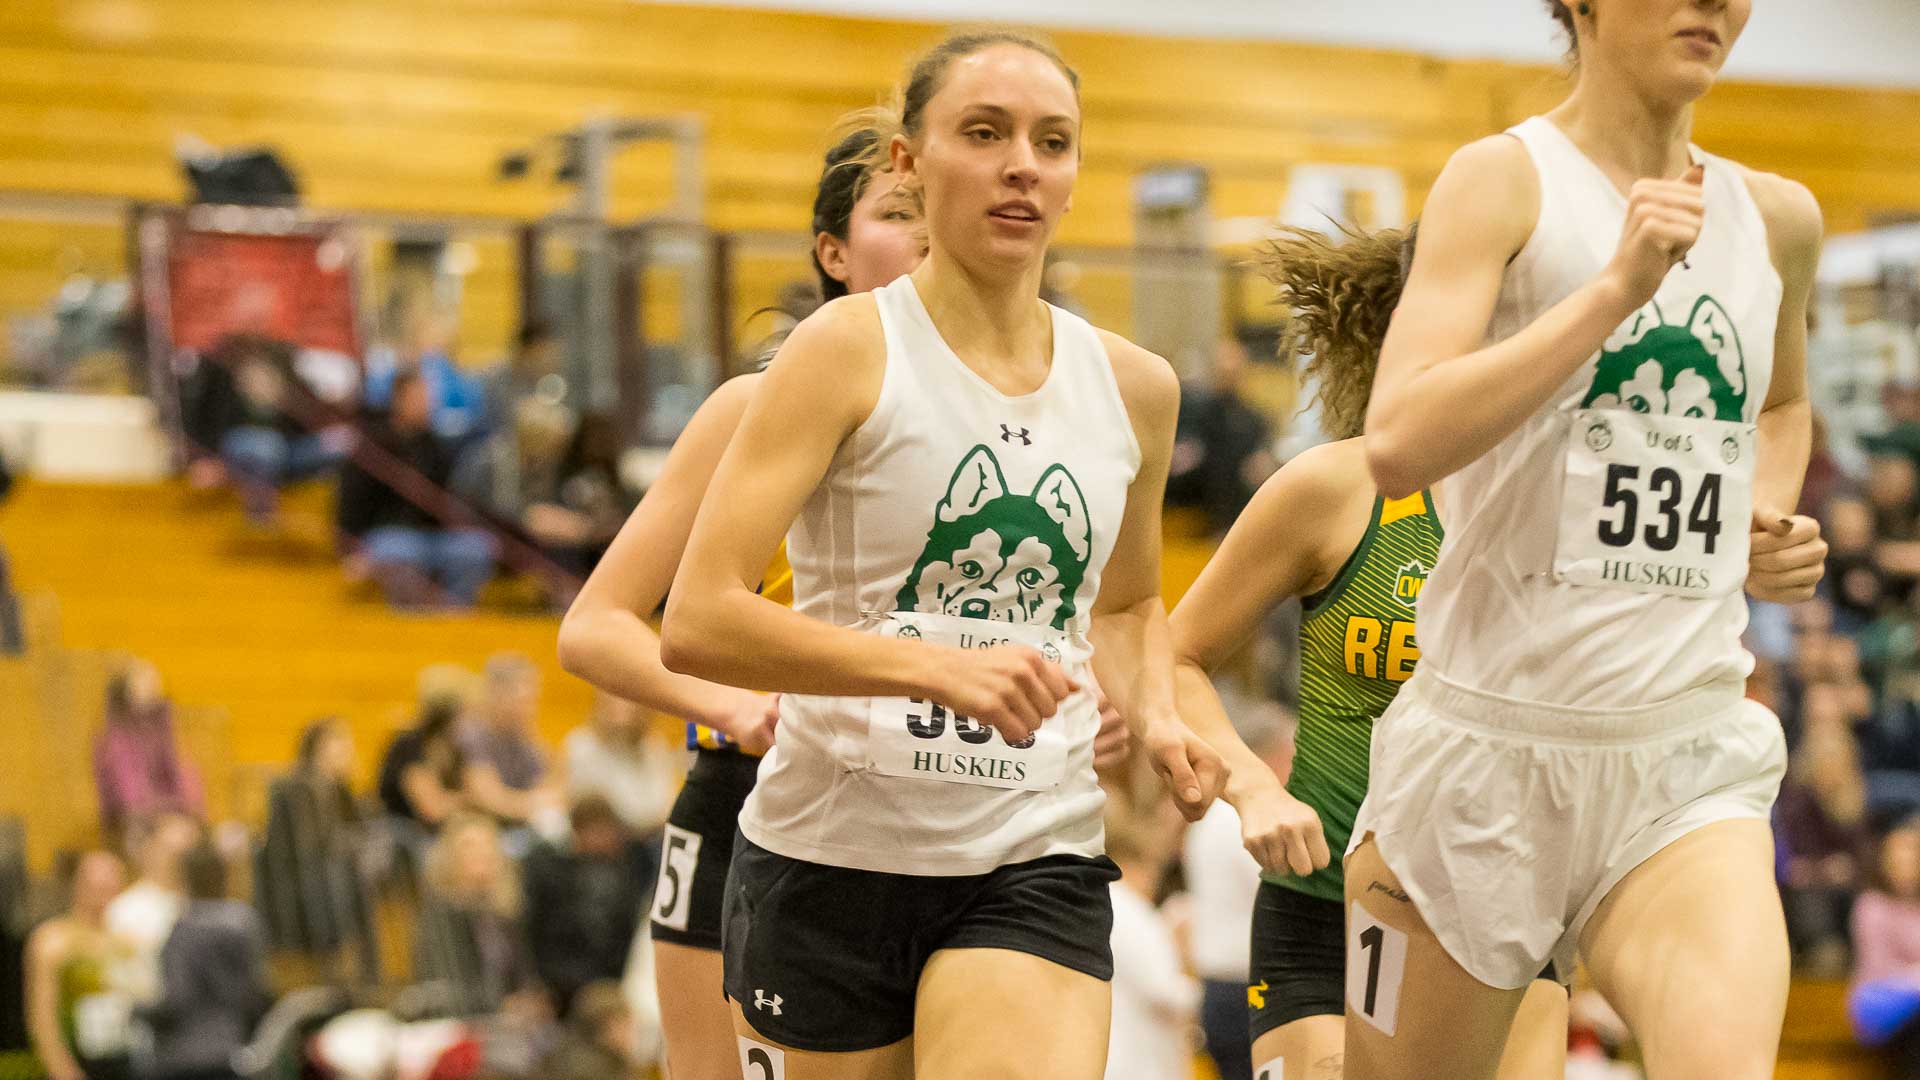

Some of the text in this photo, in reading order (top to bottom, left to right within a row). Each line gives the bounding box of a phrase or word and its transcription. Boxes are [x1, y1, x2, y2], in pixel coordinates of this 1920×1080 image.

[1646, 432, 1658, 448] U
[1685, 436, 1694, 451] S
[1598, 463, 1723, 554] 534
[1601, 560, 1711, 589] HUSKIES
[1344, 615, 1421, 680] RE
[914, 751, 1026, 781] HUSKIES
[659, 834, 686, 918] 5
[1360, 924, 1384, 1018] 1
